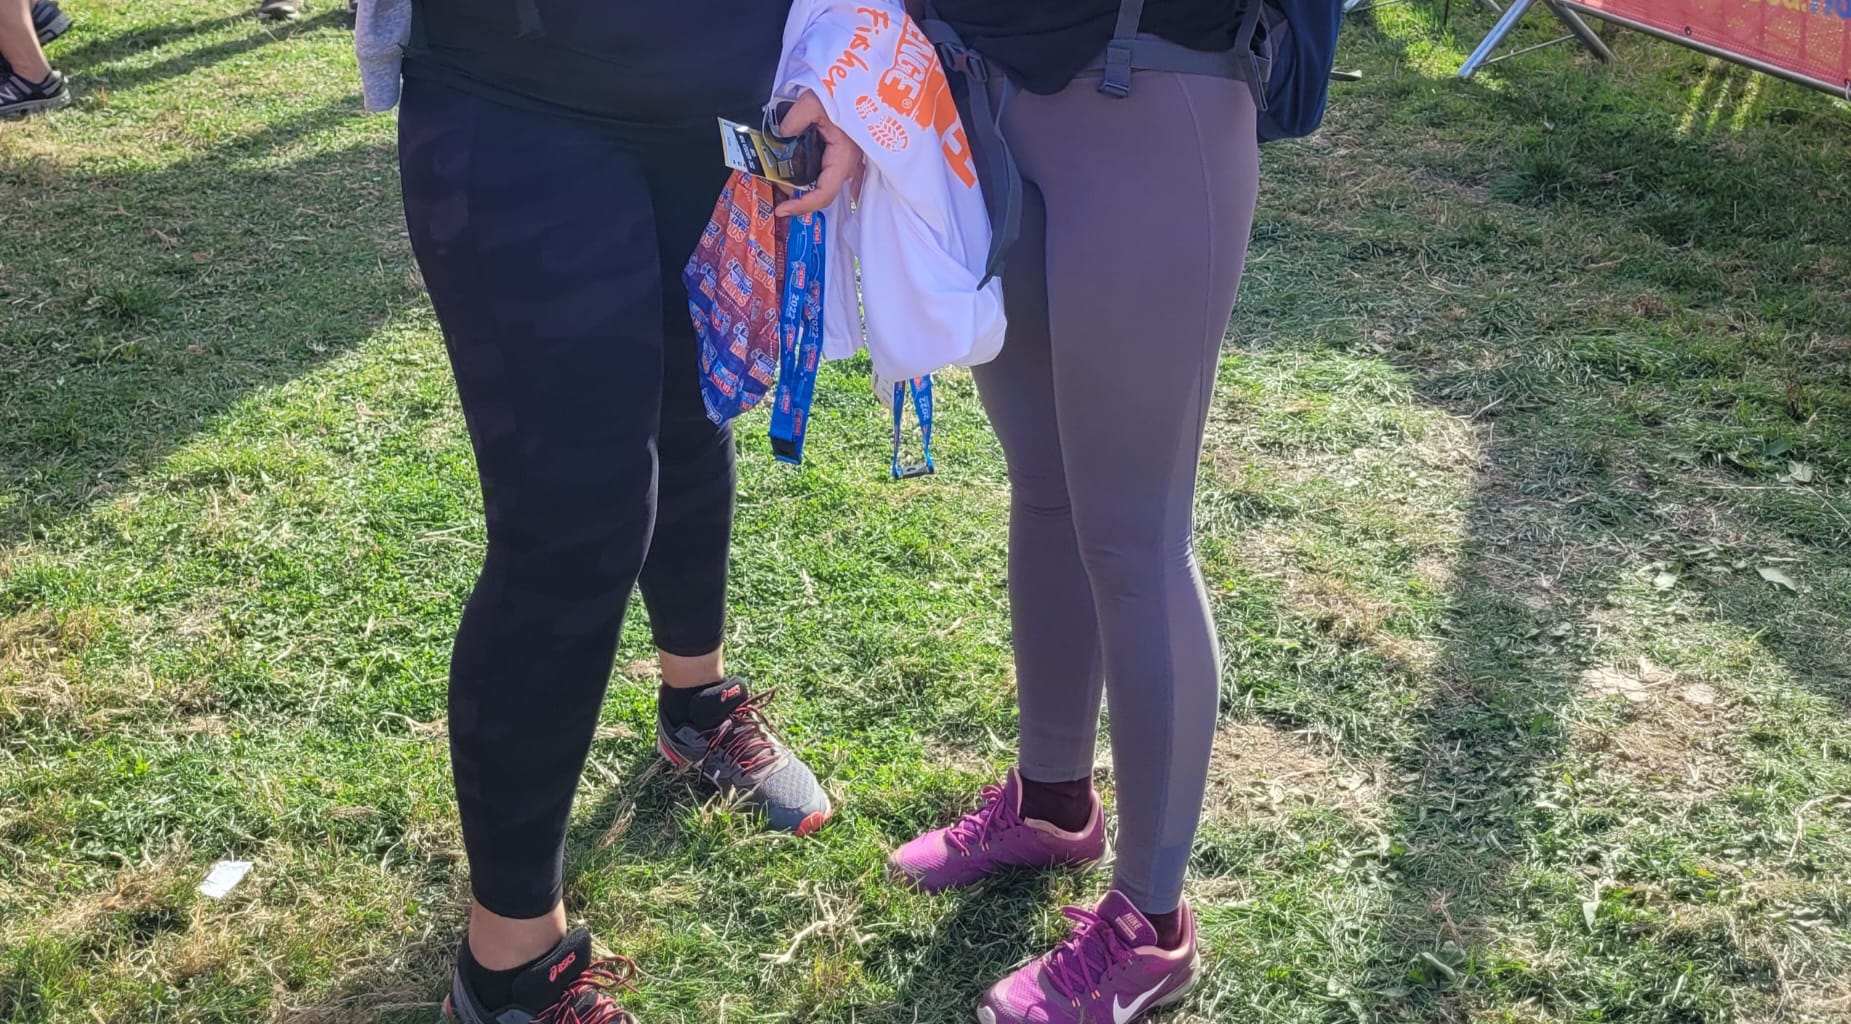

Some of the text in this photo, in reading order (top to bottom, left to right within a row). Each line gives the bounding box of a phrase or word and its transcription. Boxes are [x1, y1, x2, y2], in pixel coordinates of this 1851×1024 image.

[721, 275, 749, 307] SOUTH
[788, 293, 800, 320] 2022
[918, 396, 930, 421] 2022
[1119, 912, 1143, 932] NIKE
